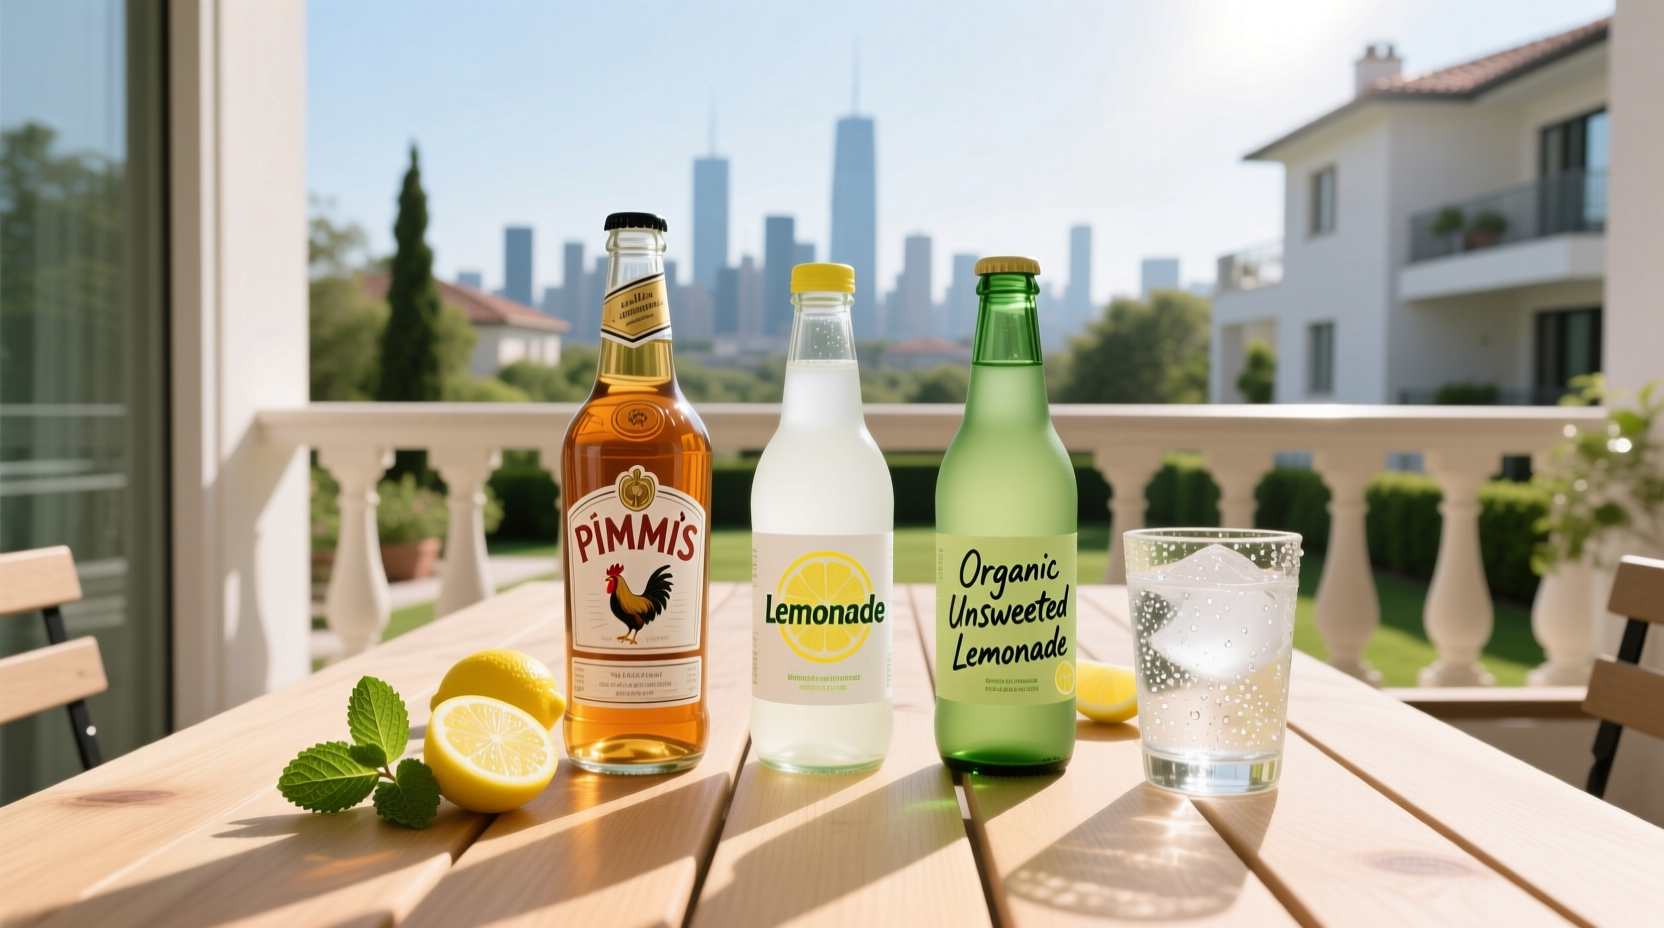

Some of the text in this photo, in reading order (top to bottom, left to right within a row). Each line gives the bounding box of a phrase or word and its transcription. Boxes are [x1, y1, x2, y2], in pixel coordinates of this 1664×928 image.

[959, 549, 1060, 600] Organic
[765, 593, 886, 625] Lemonade
[949, 584, 1069, 629] Unsweeted
[952, 624, 1068, 671] Lemonade
